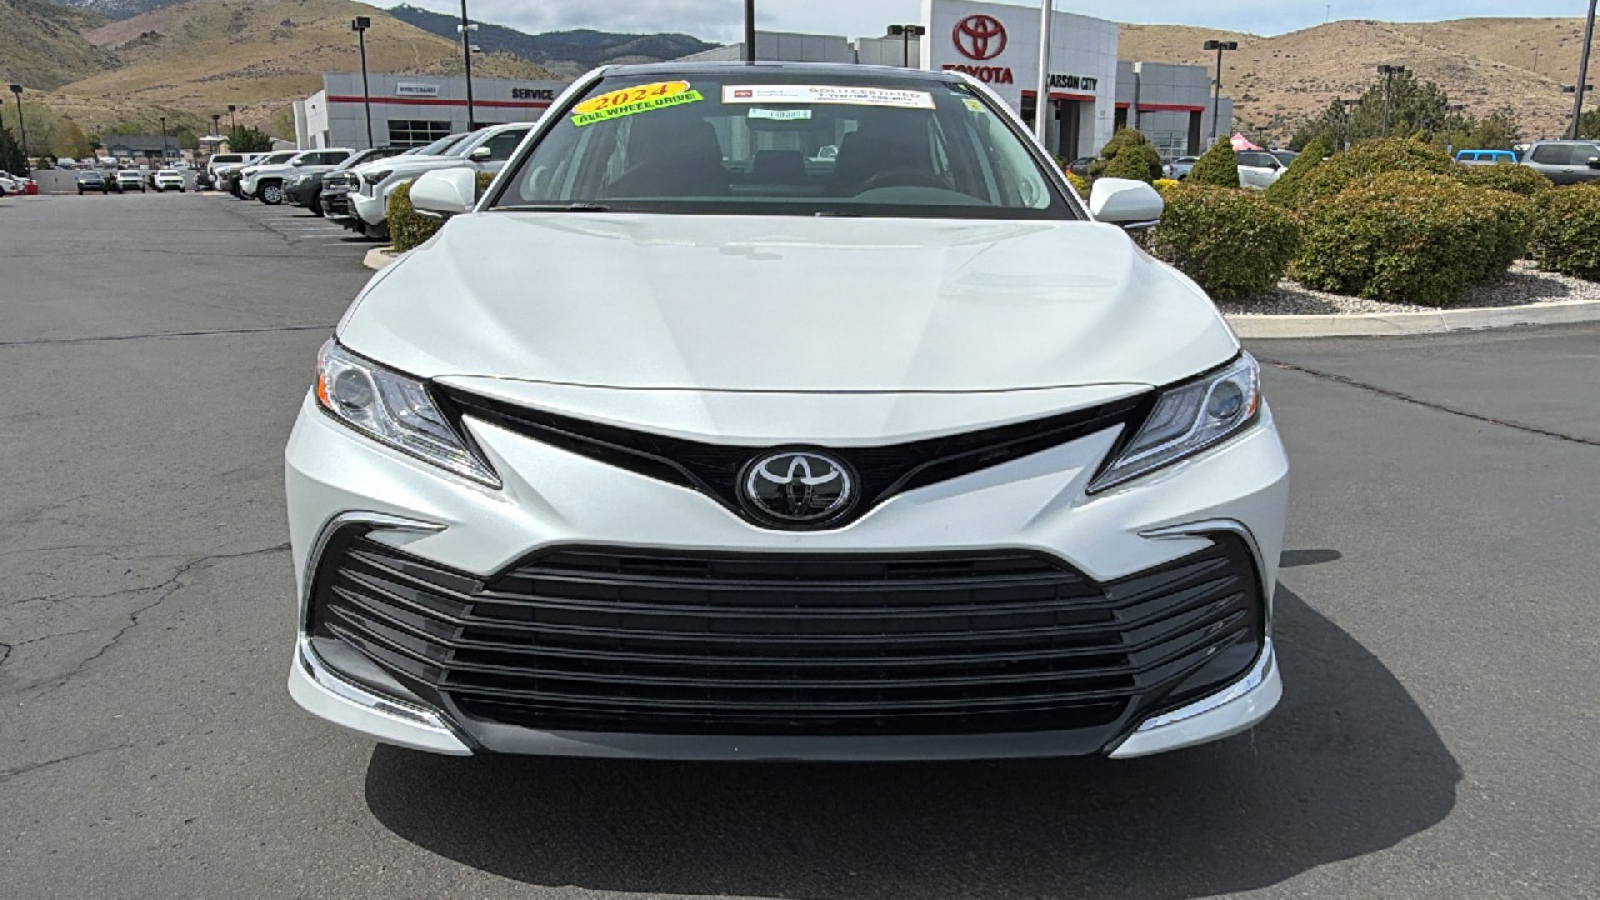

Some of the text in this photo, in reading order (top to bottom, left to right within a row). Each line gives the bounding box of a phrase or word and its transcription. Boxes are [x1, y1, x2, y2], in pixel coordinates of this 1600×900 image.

[1081, 77, 1098, 91] CITY
[512, 87, 554, 100] SERVICE
[594, 84, 668, 110] 2024
[579, 111, 605, 123] ALL
[606, 101, 651, 116] WHEEL
